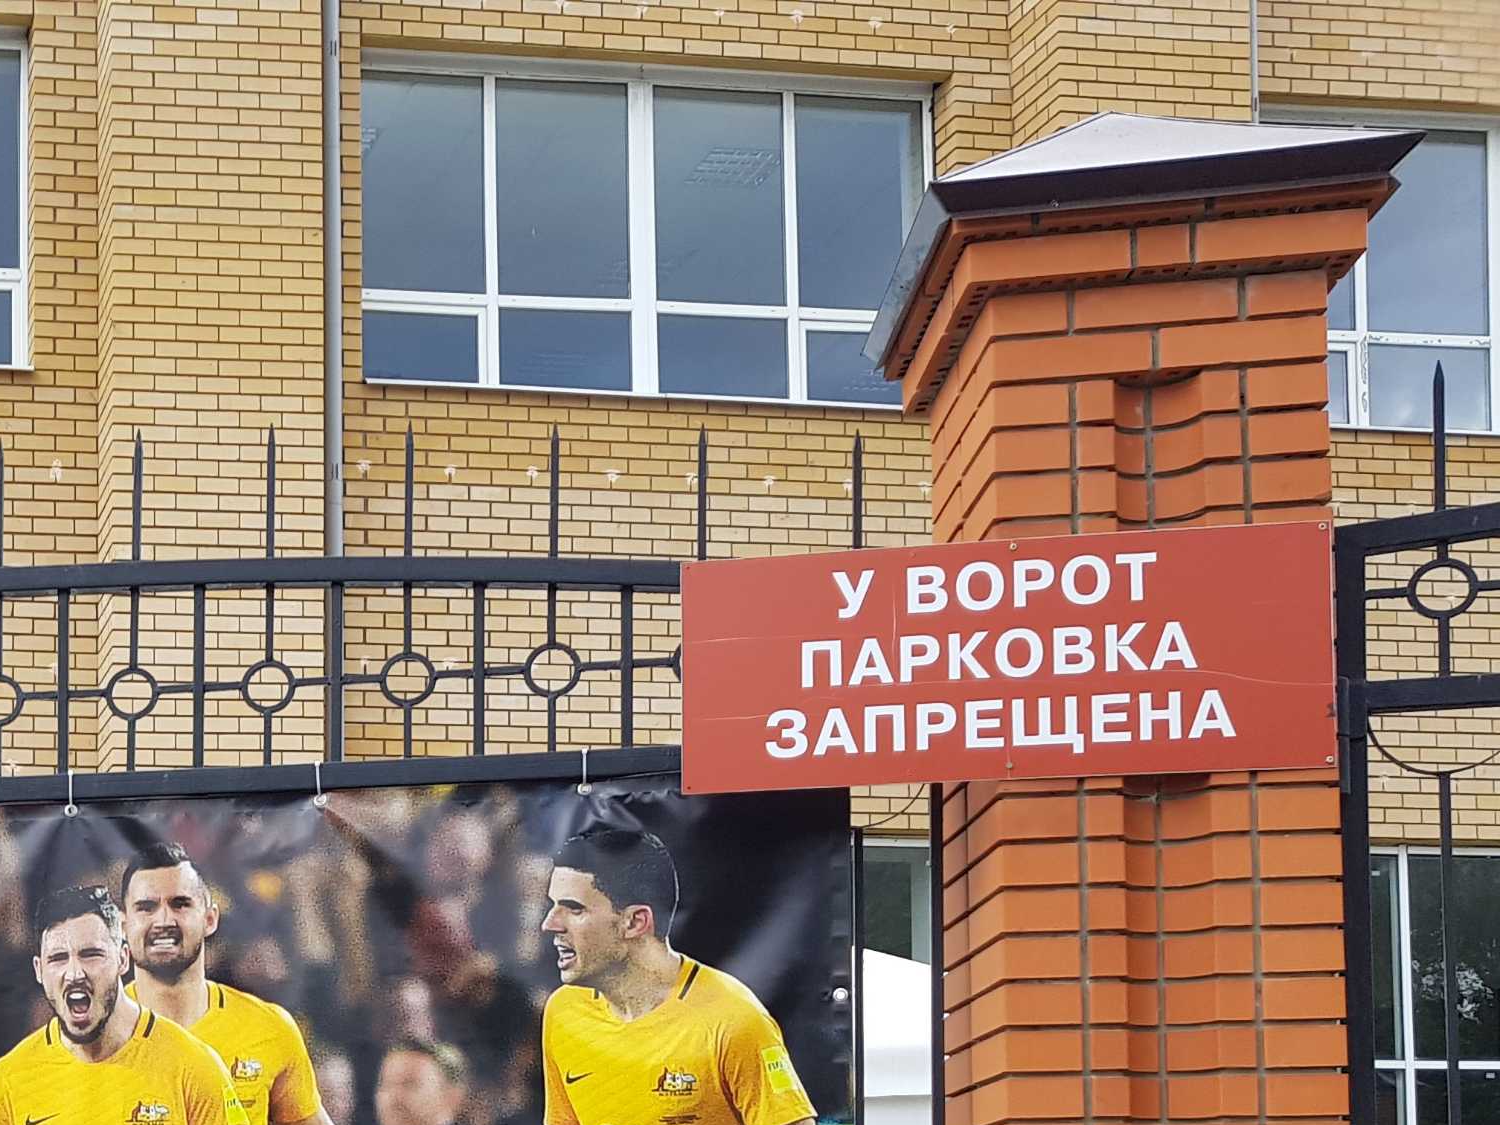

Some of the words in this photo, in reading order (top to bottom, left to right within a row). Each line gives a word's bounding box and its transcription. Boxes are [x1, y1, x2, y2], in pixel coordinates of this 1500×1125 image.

[832, 569, 875, 618] У
[906, 551, 1157, 614] ВОРОТ
[800, 621, 1198, 688] ПАРКОВКА
[765, 689, 1237, 759] ЗАПРЕЩЕНА
